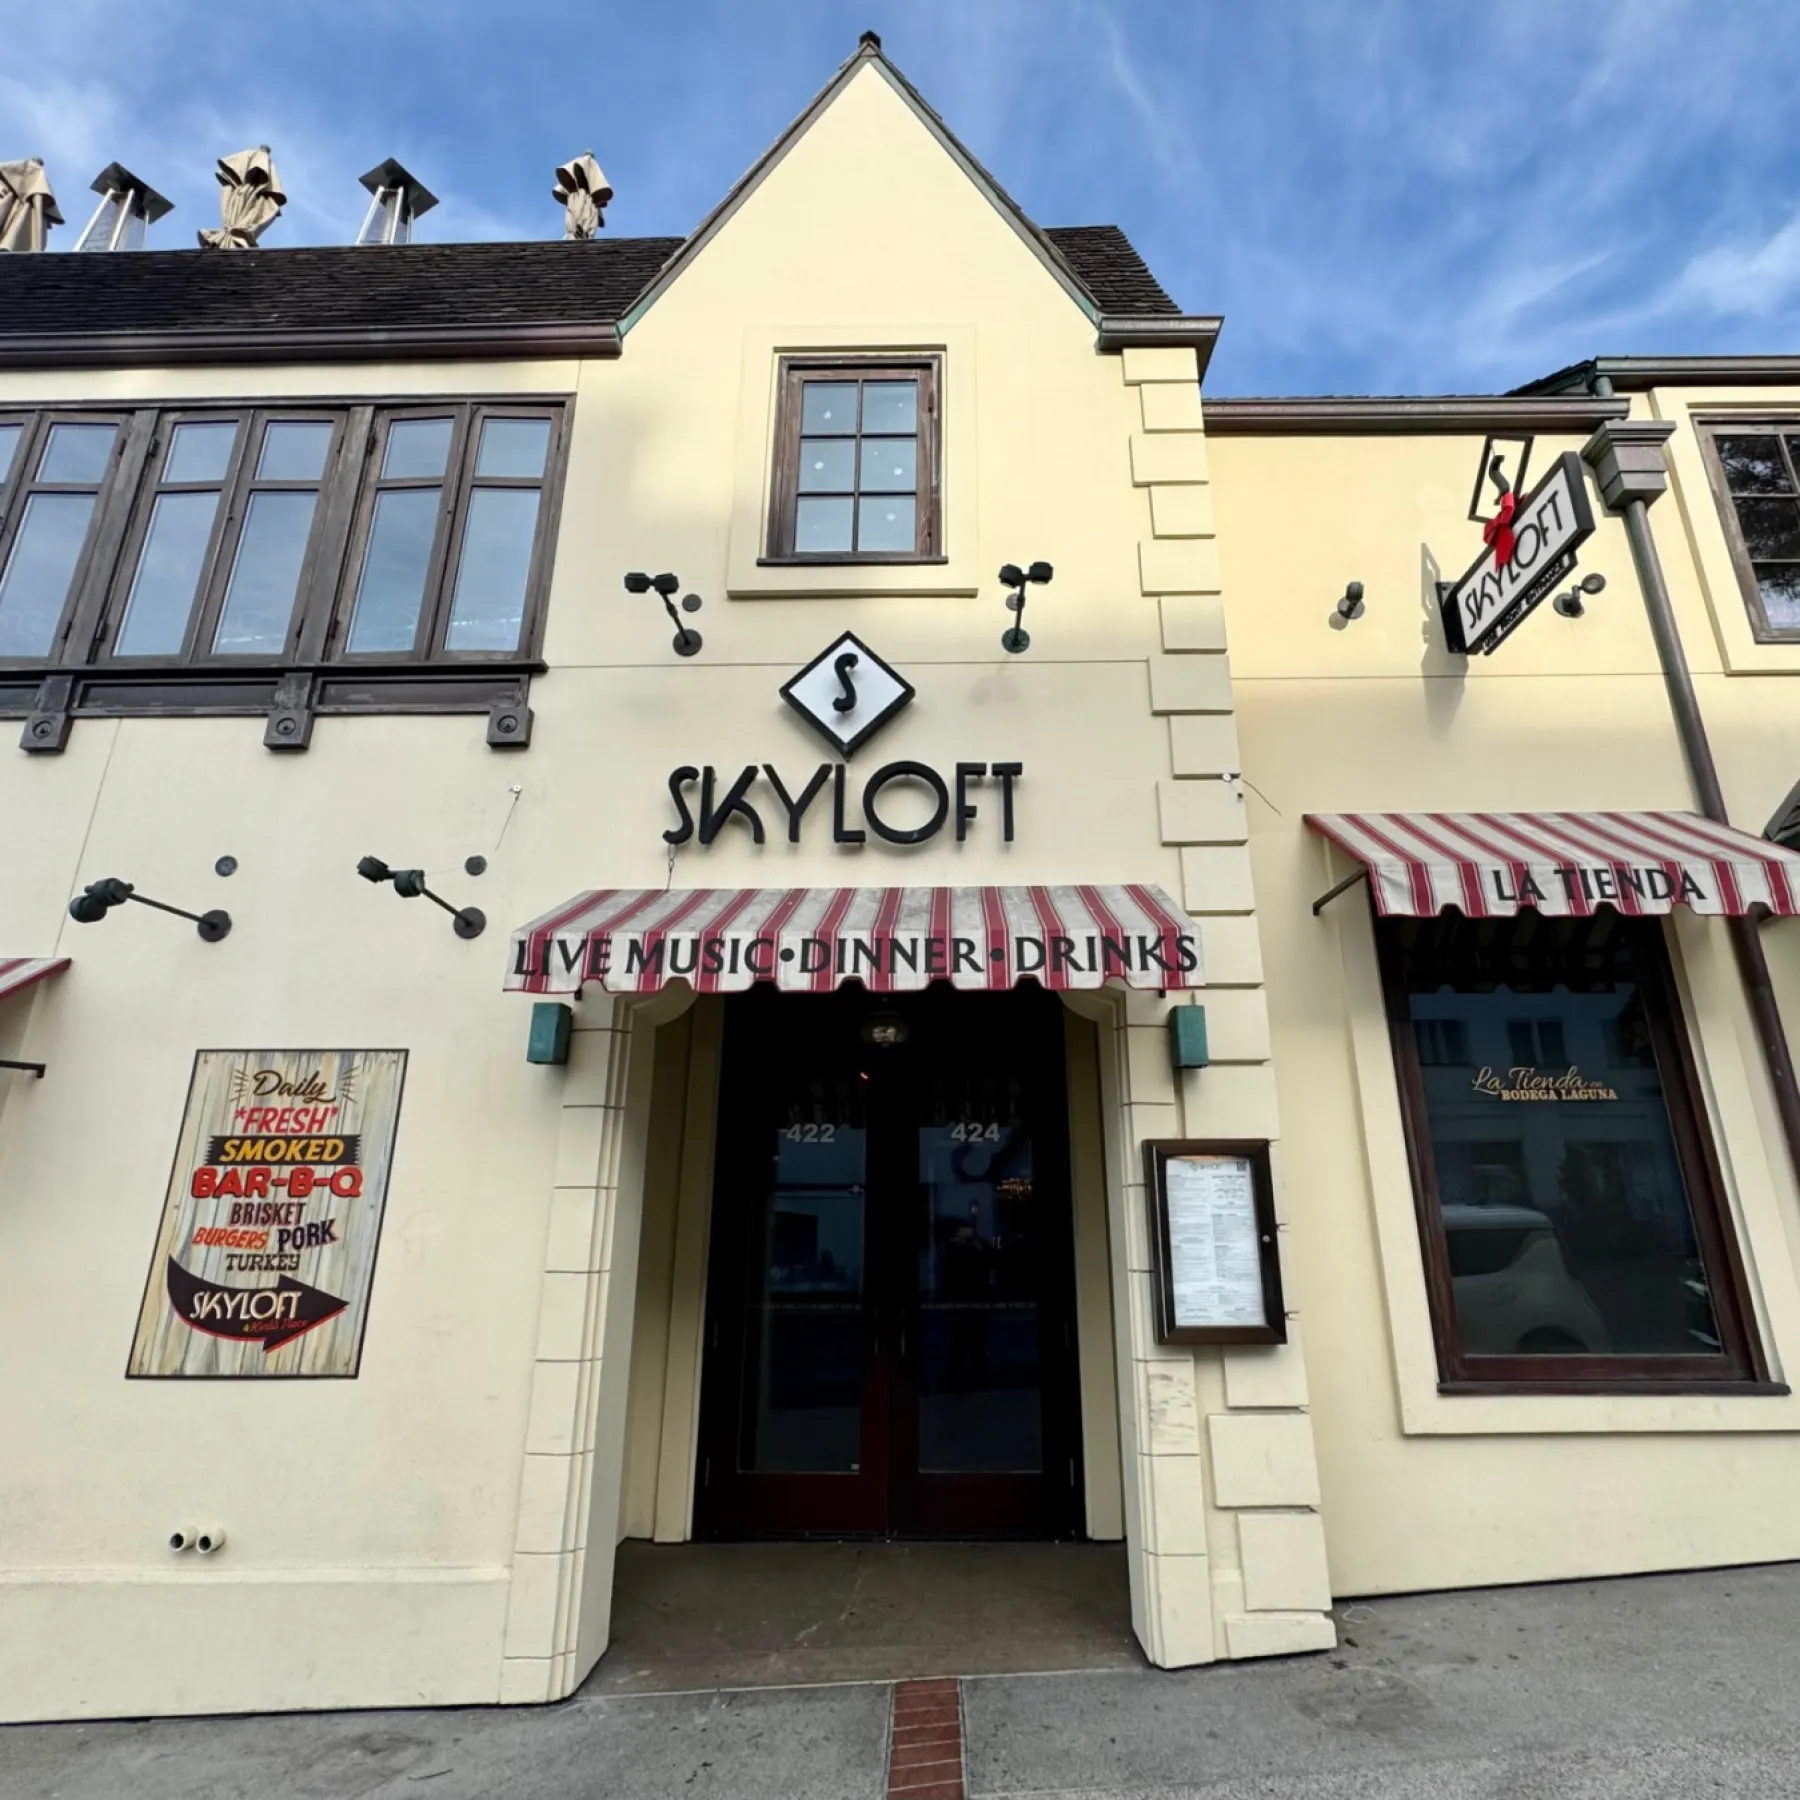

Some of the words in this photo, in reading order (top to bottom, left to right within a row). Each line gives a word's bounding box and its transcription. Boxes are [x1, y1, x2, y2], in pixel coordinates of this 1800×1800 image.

[662, 760, 1023, 845] SKYLOFT
[1492, 869, 1548, 901] LA
[1553, 868, 1707, 901] TIENDA
[513, 938, 612, 976] LIVE
[625, 937, 774, 976] MUSIC
[800, 937, 986, 975] DINNER
[1015, 935, 1199, 973] DRINKS
[253, 1069, 337, 1104] Daily
[1472, 1065, 1506, 1095] La
[1508, 1065, 1587, 1090] Tienda
[1501, 1088, 1559, 1101] BODEGA
[1561, 1088, 1619, 1101] LAGUNA
[785, 1123, 836, 1143] 422
[950, 1122, 1001, 1143] 424
[218, 1138, 345, 1163] SMOKED
[191, 1166, 364, 1199] BAR-B-Q
[229, 1202, 307, 1226] BRISKET
[191, 1226, 270, 1250] BURGERS
[277, 1218, 338, 1253] PORK
[226, 1253, 301, 1271] TURKEY
[189, 1291, 303, 1320] SKYLOFT
